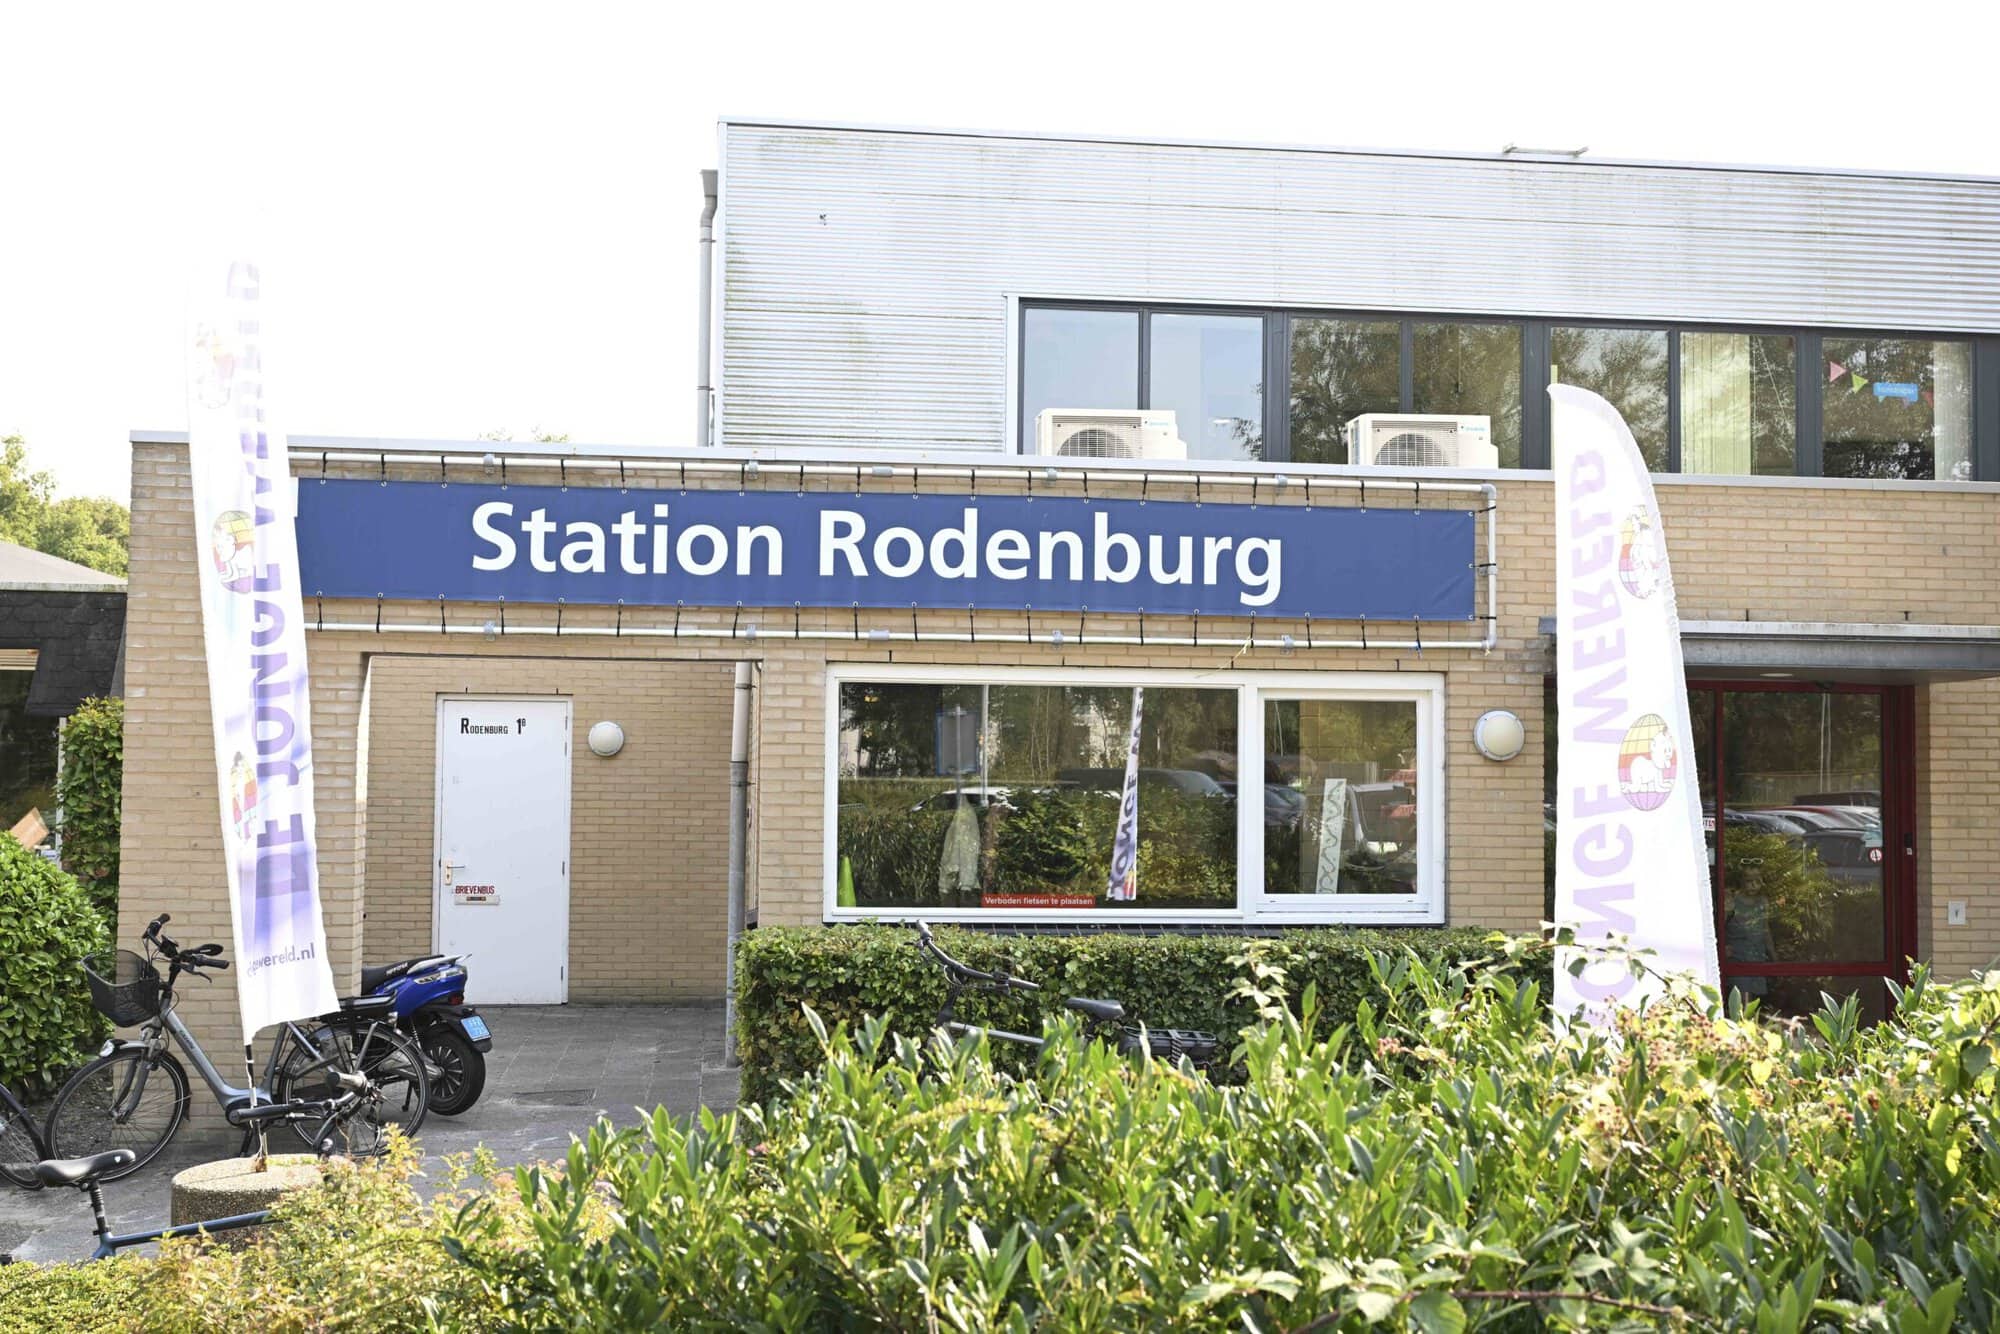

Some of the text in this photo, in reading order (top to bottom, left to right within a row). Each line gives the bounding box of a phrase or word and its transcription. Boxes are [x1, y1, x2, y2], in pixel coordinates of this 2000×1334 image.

[471, 502, 1282, 606] Station Rodenburg
[250, 562, 300, 788] JONGE
[255, 813, 311, 900] DE
[455, 885, 495, 894] BRIEVENBUS
[984, 896, 1093, 906] Verboden fietsen te plaatsen
